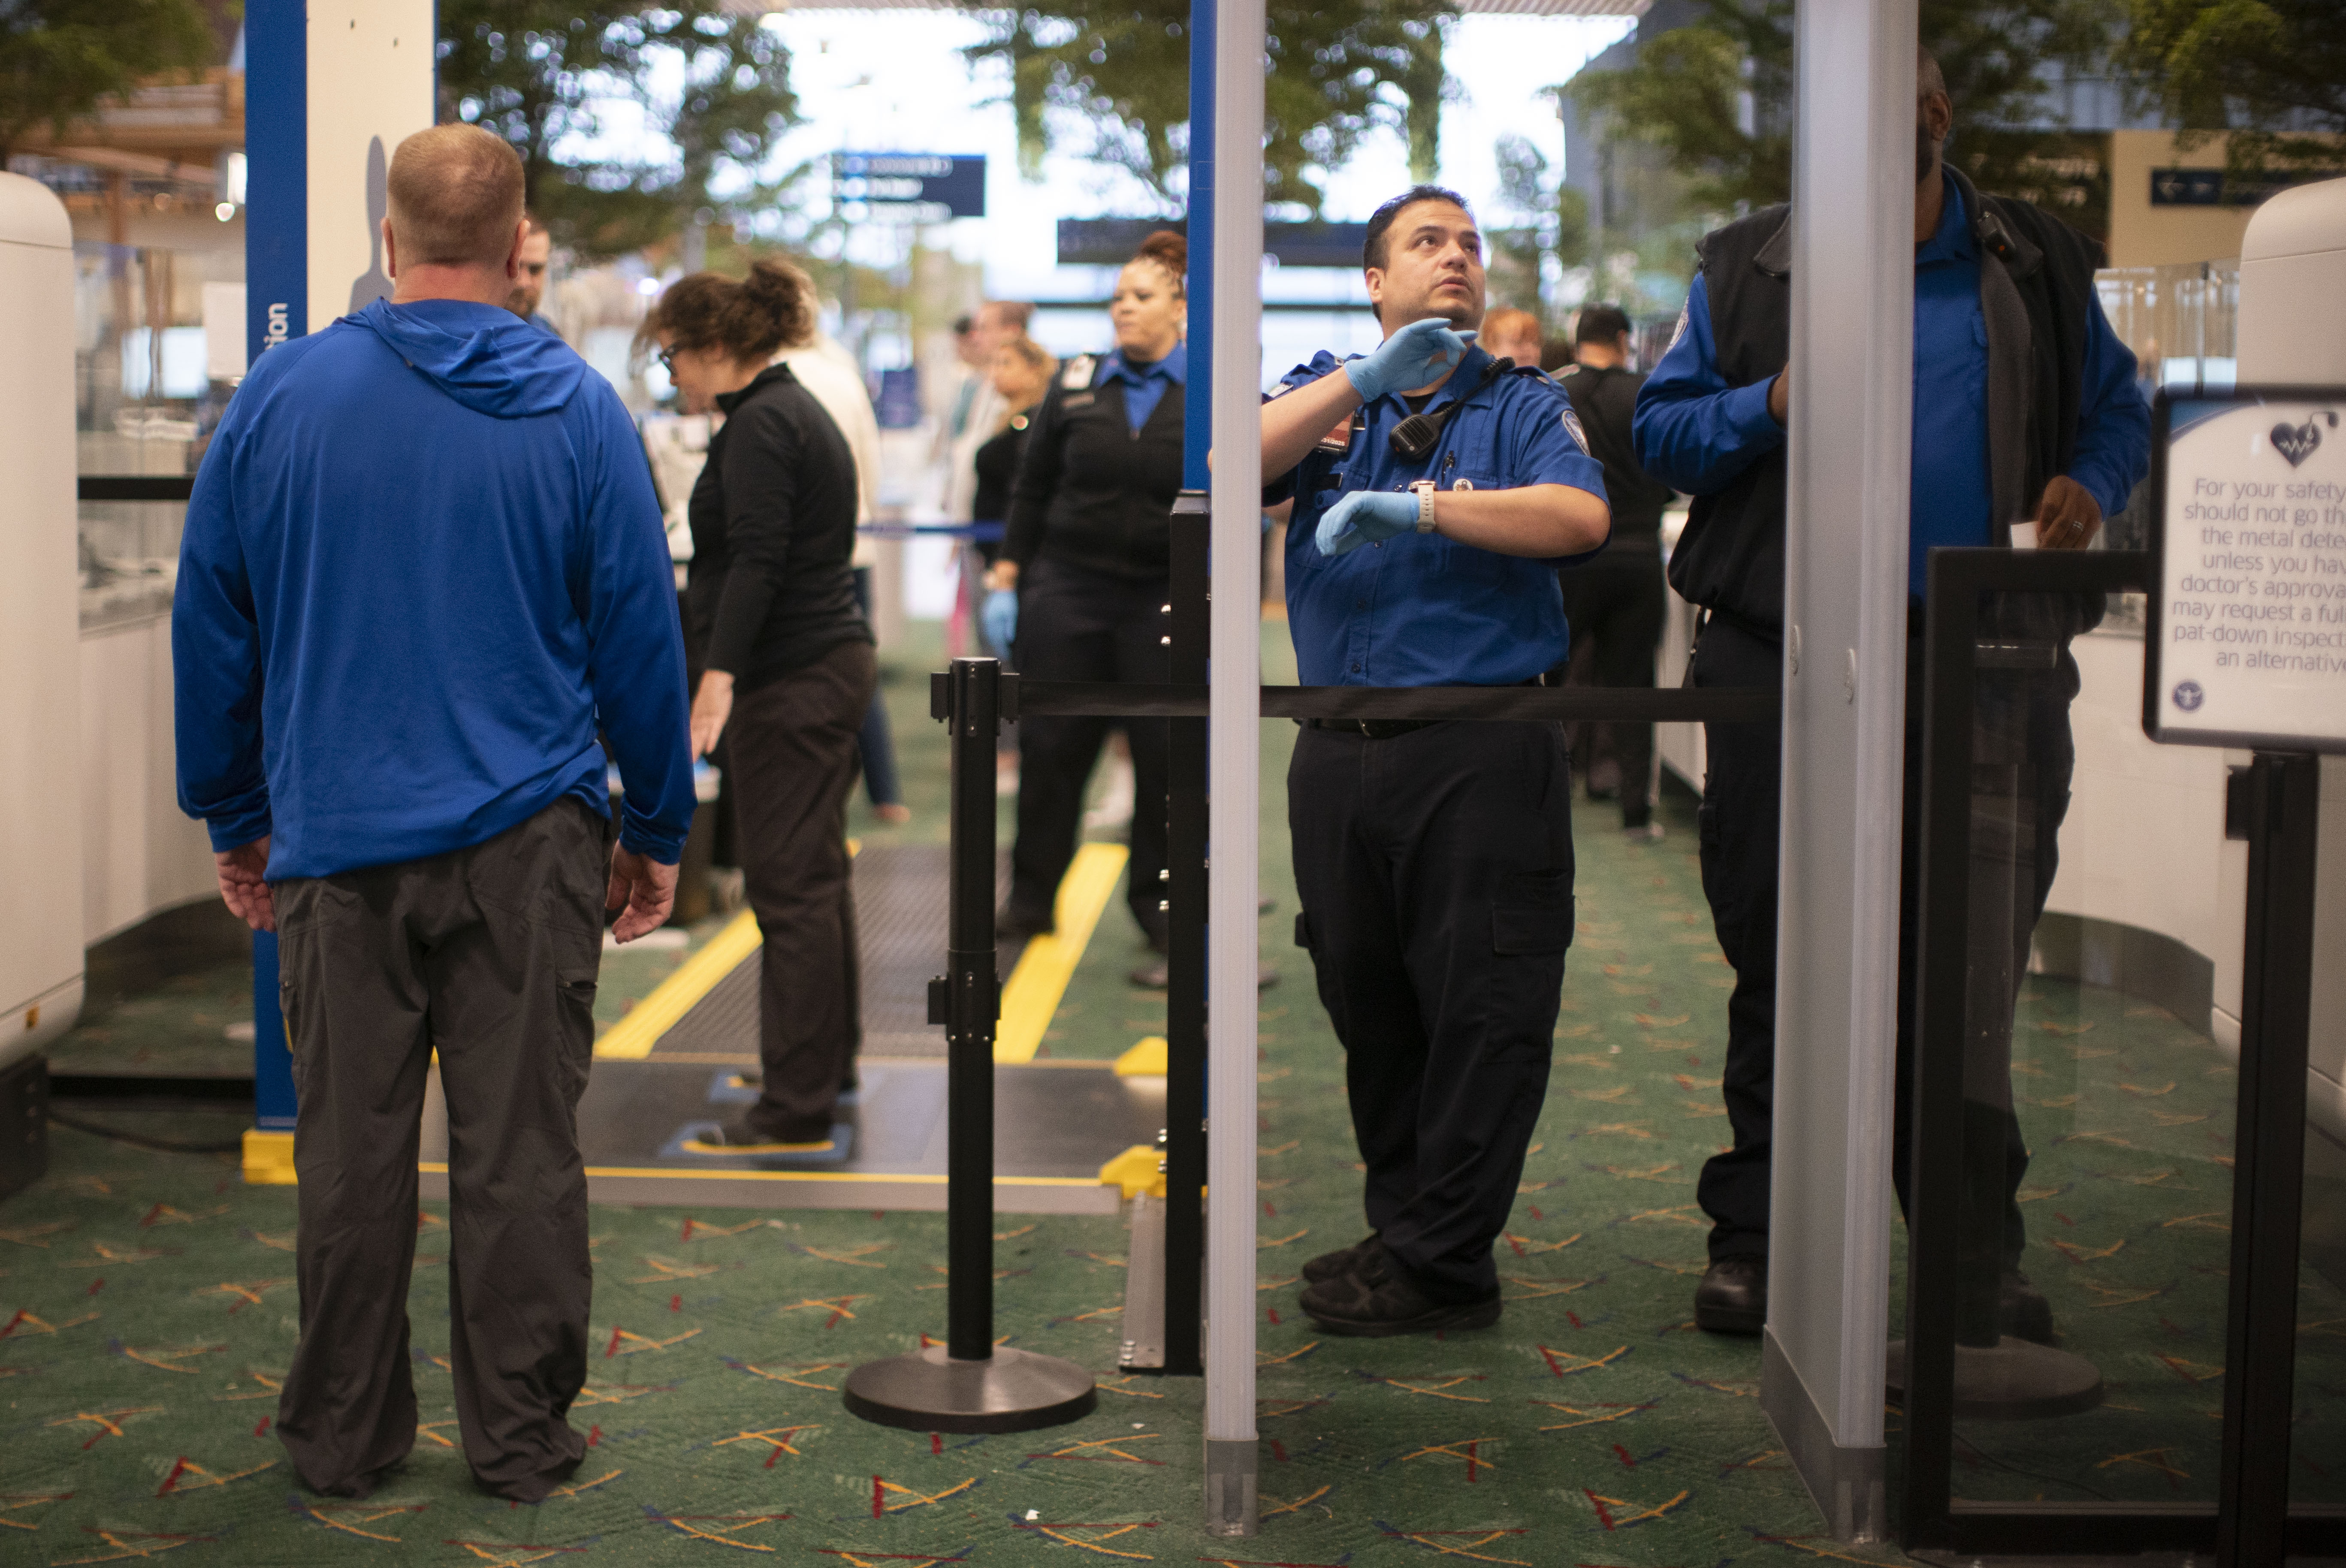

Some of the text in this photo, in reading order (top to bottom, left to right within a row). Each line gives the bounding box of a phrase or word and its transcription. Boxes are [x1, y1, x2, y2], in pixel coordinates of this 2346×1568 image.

[263, 302, 288, 350] ion
[2195, 478, 2346, 503] For your safety
[2185, 502, 2346, 526] should not go th
[2202, 526, 2346, 549] the metal dete
[2202, 551, 2264, 571] unless
[2271, 557, 2307, 574] you
[2181, 574, 2346, 600] doctor's approva
[2173, 601, 2216, 620] may
[2221, 604, 2295, 622] request
[2301, 607, 2312, 622] a
[2174, 624, 2346, 649] pat-down inspect
[2216, 651, 2240, 666] an
